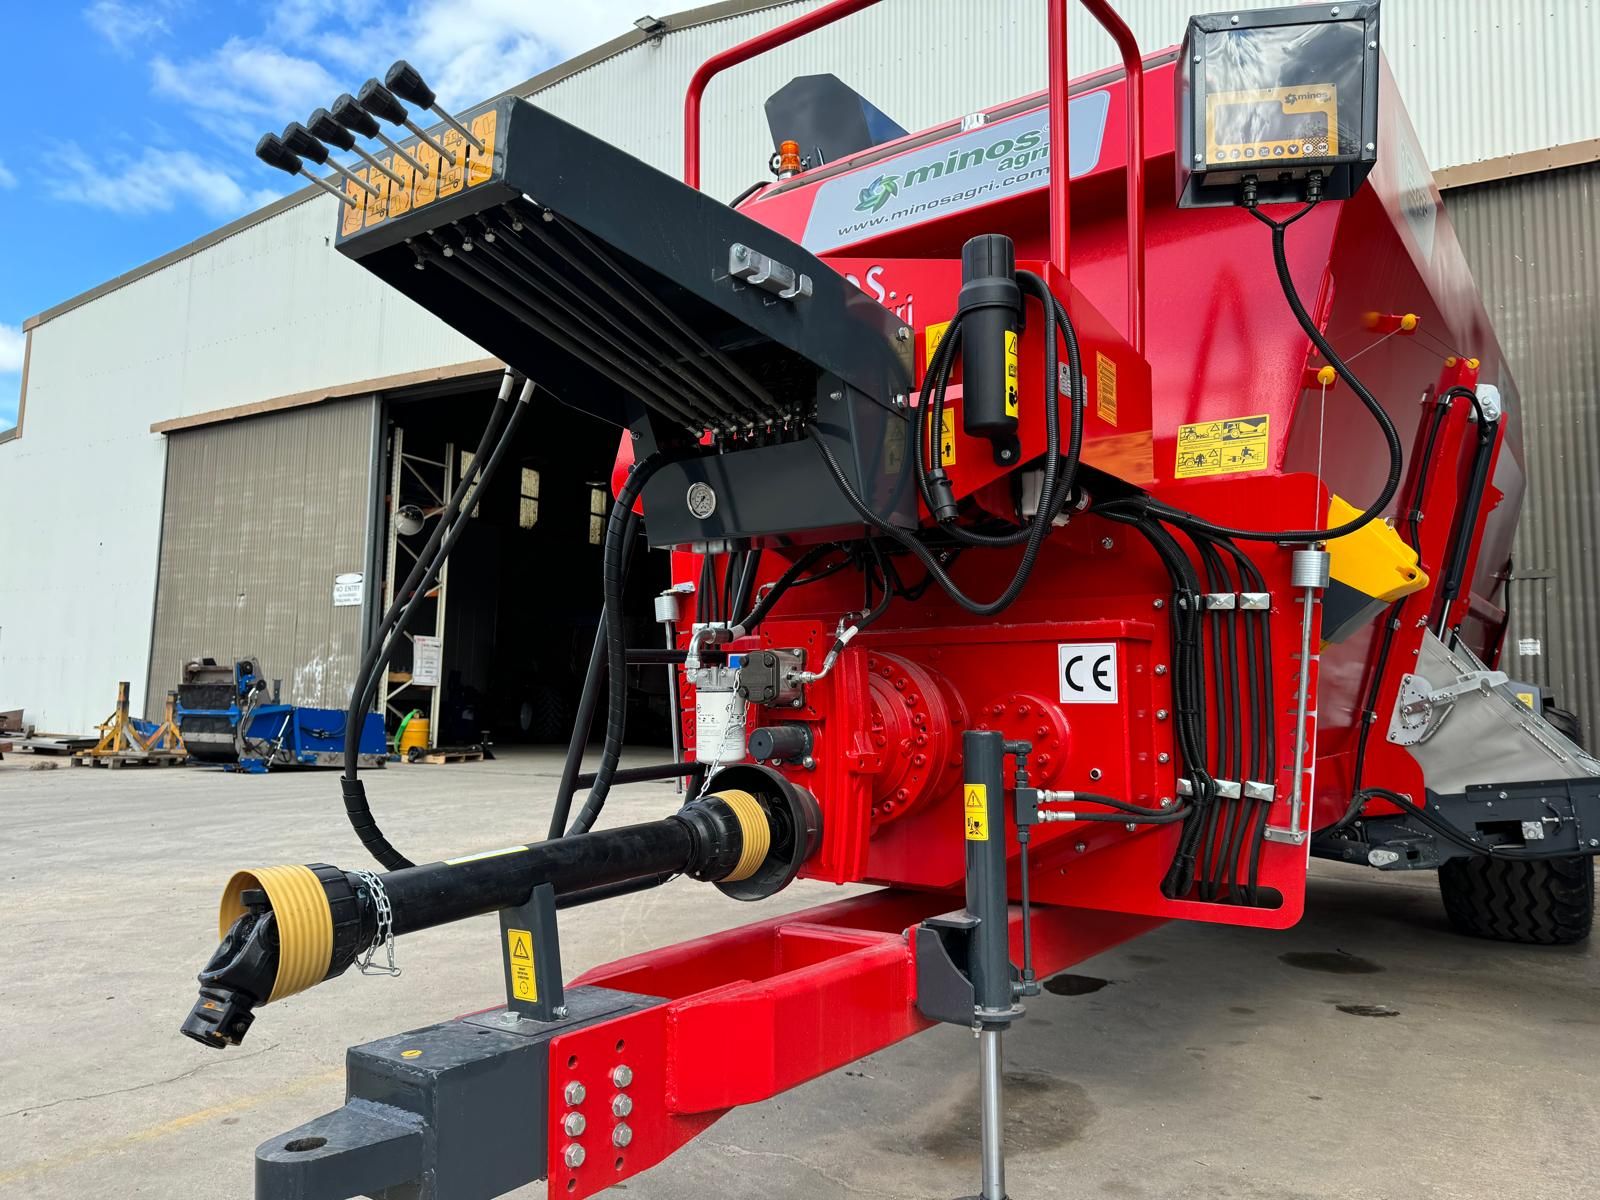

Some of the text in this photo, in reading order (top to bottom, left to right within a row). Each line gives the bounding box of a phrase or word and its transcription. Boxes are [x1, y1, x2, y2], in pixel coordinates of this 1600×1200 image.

[903, 130, 1041, 188] minos
[997, 142, 1049, 172] agri
[838, 166, 1049, 236] www.minosagri.com
[1065, 655, 1111, 692] CE
